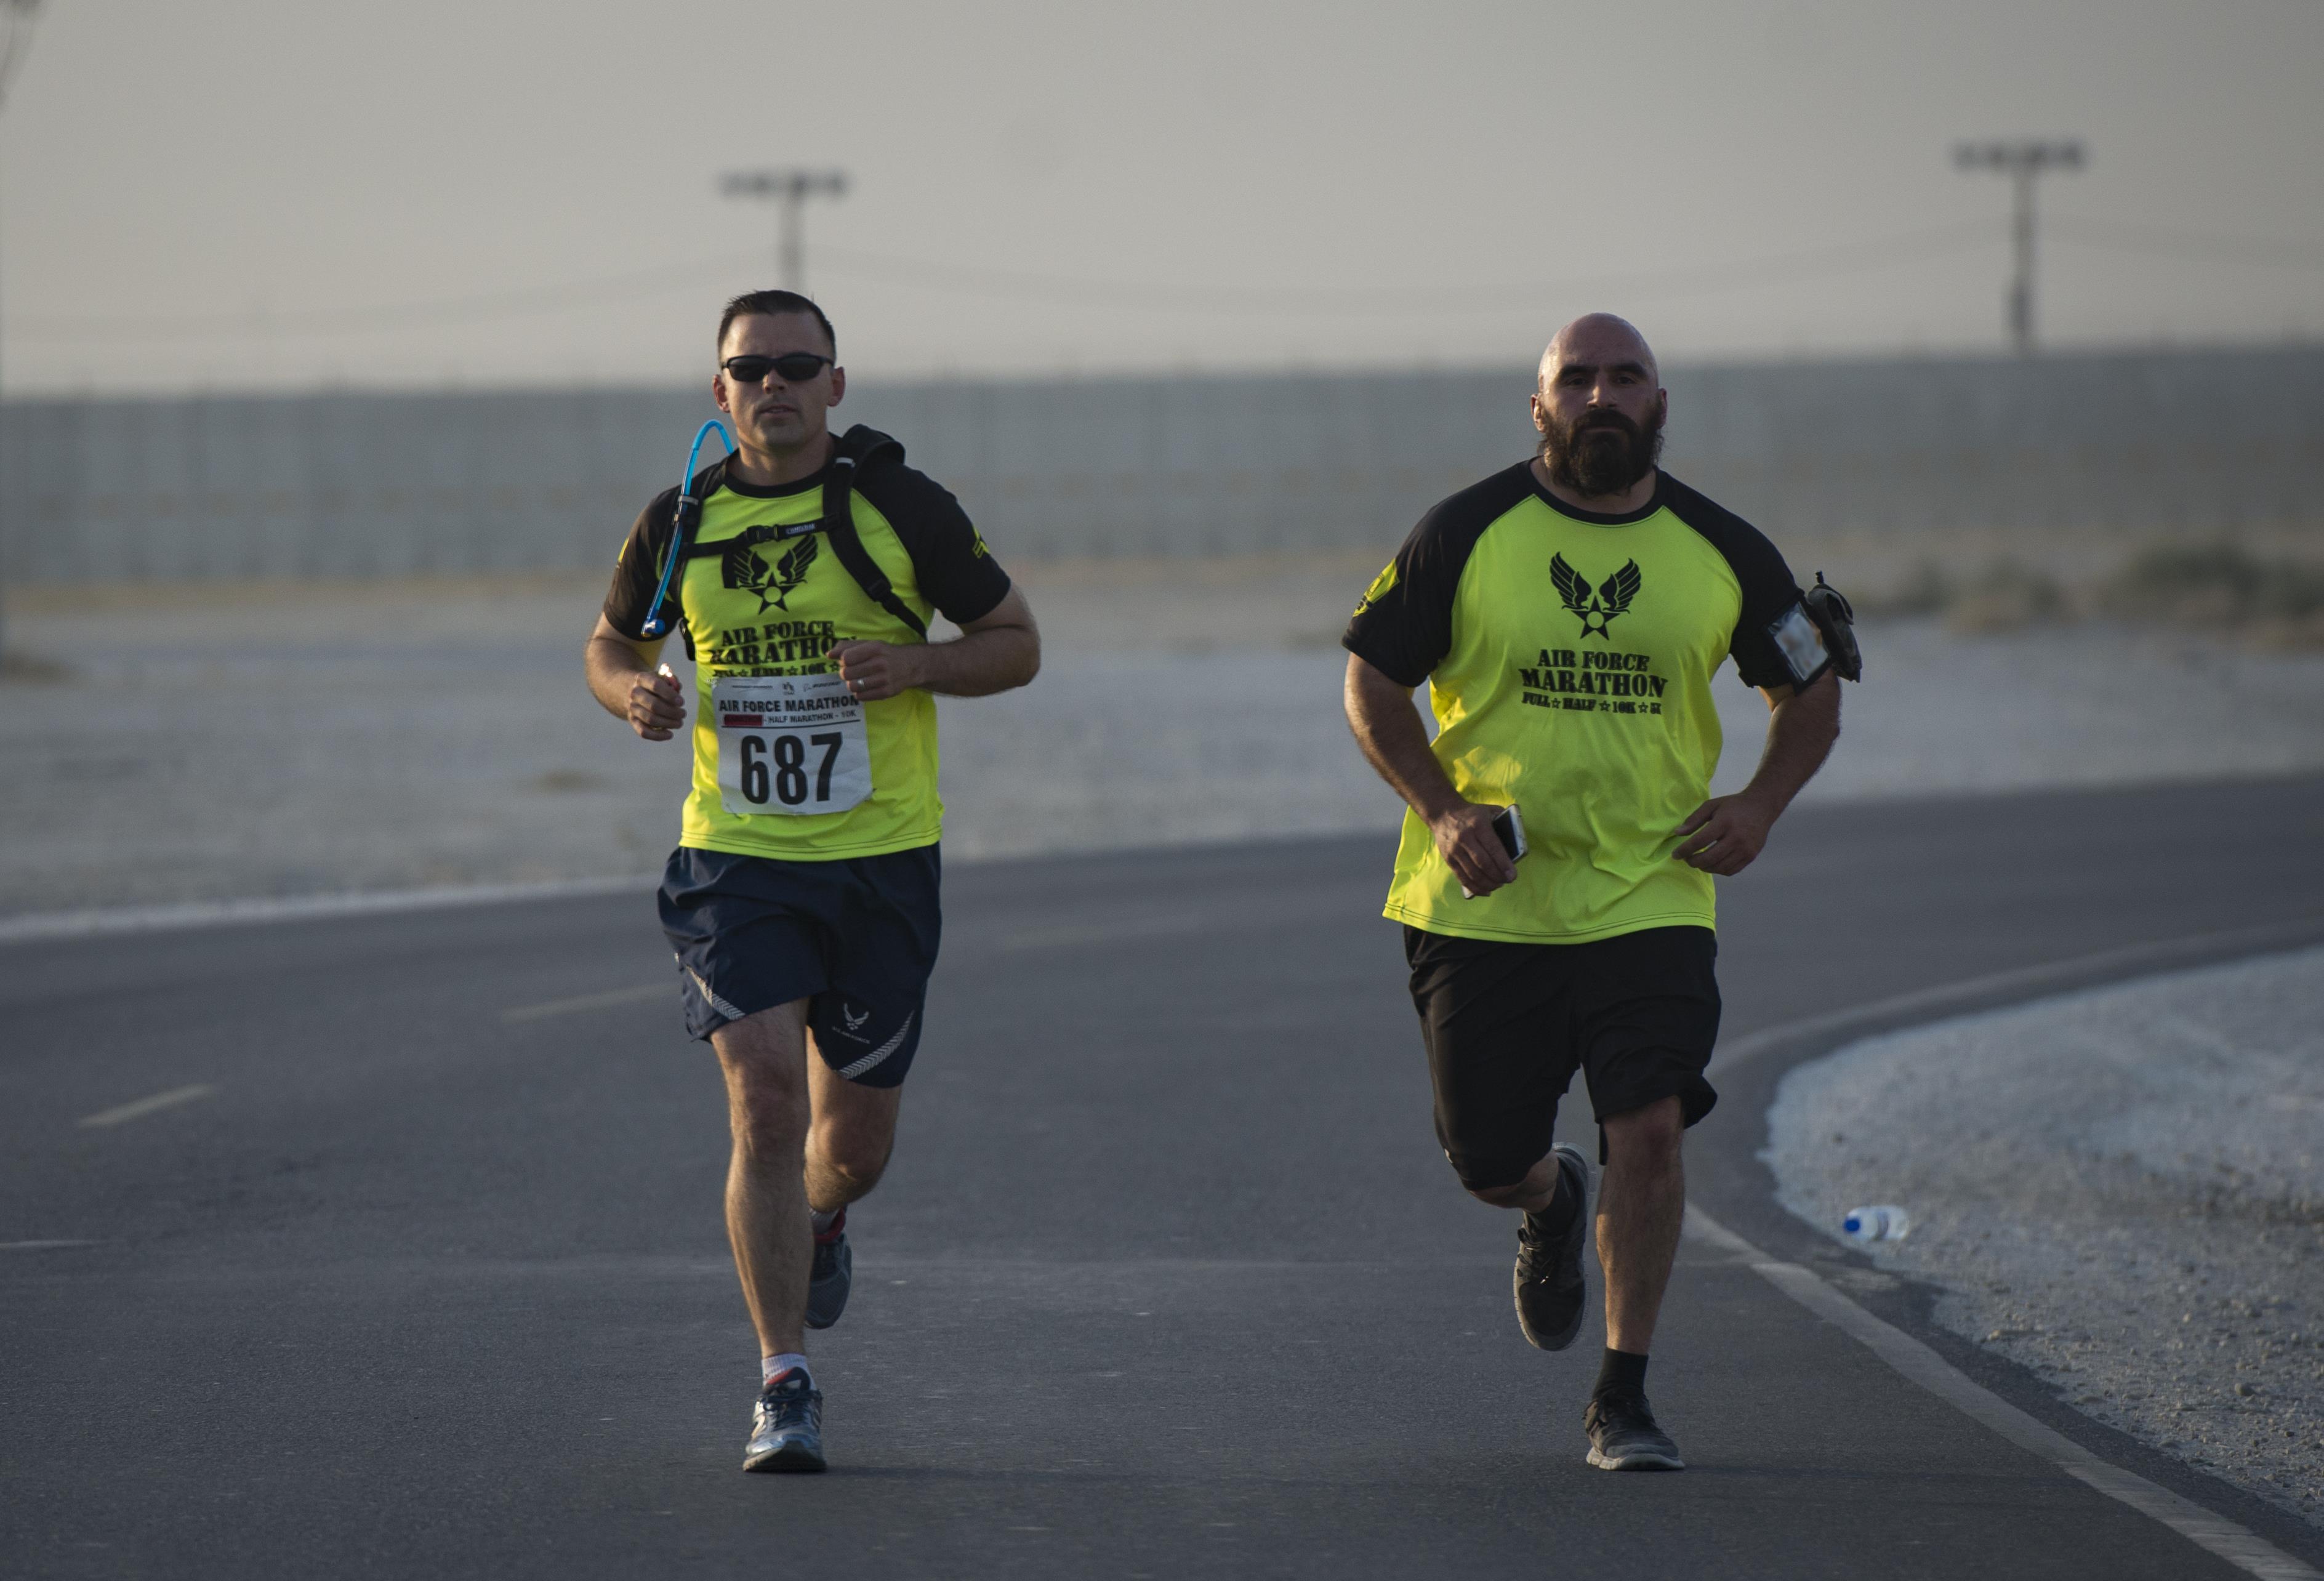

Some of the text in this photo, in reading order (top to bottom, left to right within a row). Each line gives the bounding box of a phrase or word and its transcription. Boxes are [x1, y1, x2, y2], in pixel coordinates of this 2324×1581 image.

[722, 621, 834, 646] AIR FORCE
[709, 636, 856, 665] MARATHO
[1537, 649, 1650, 672] AIR FORCE
[801, 662, 827, 675] 10K
[1518, 668, 1668, 698] MARATHON
[719, 694, 859, 712] AIR FORCE MARATHON
[1522, 691, 1550, 708] FULL
[1562, 698, 1596, 711] HALF
[1613, 701, 1636, 714] 10K
[768, 715, 788, 723] HALF
[790, 712, 834, 723] MARATHON
[741, 731, 843, 805] 687
